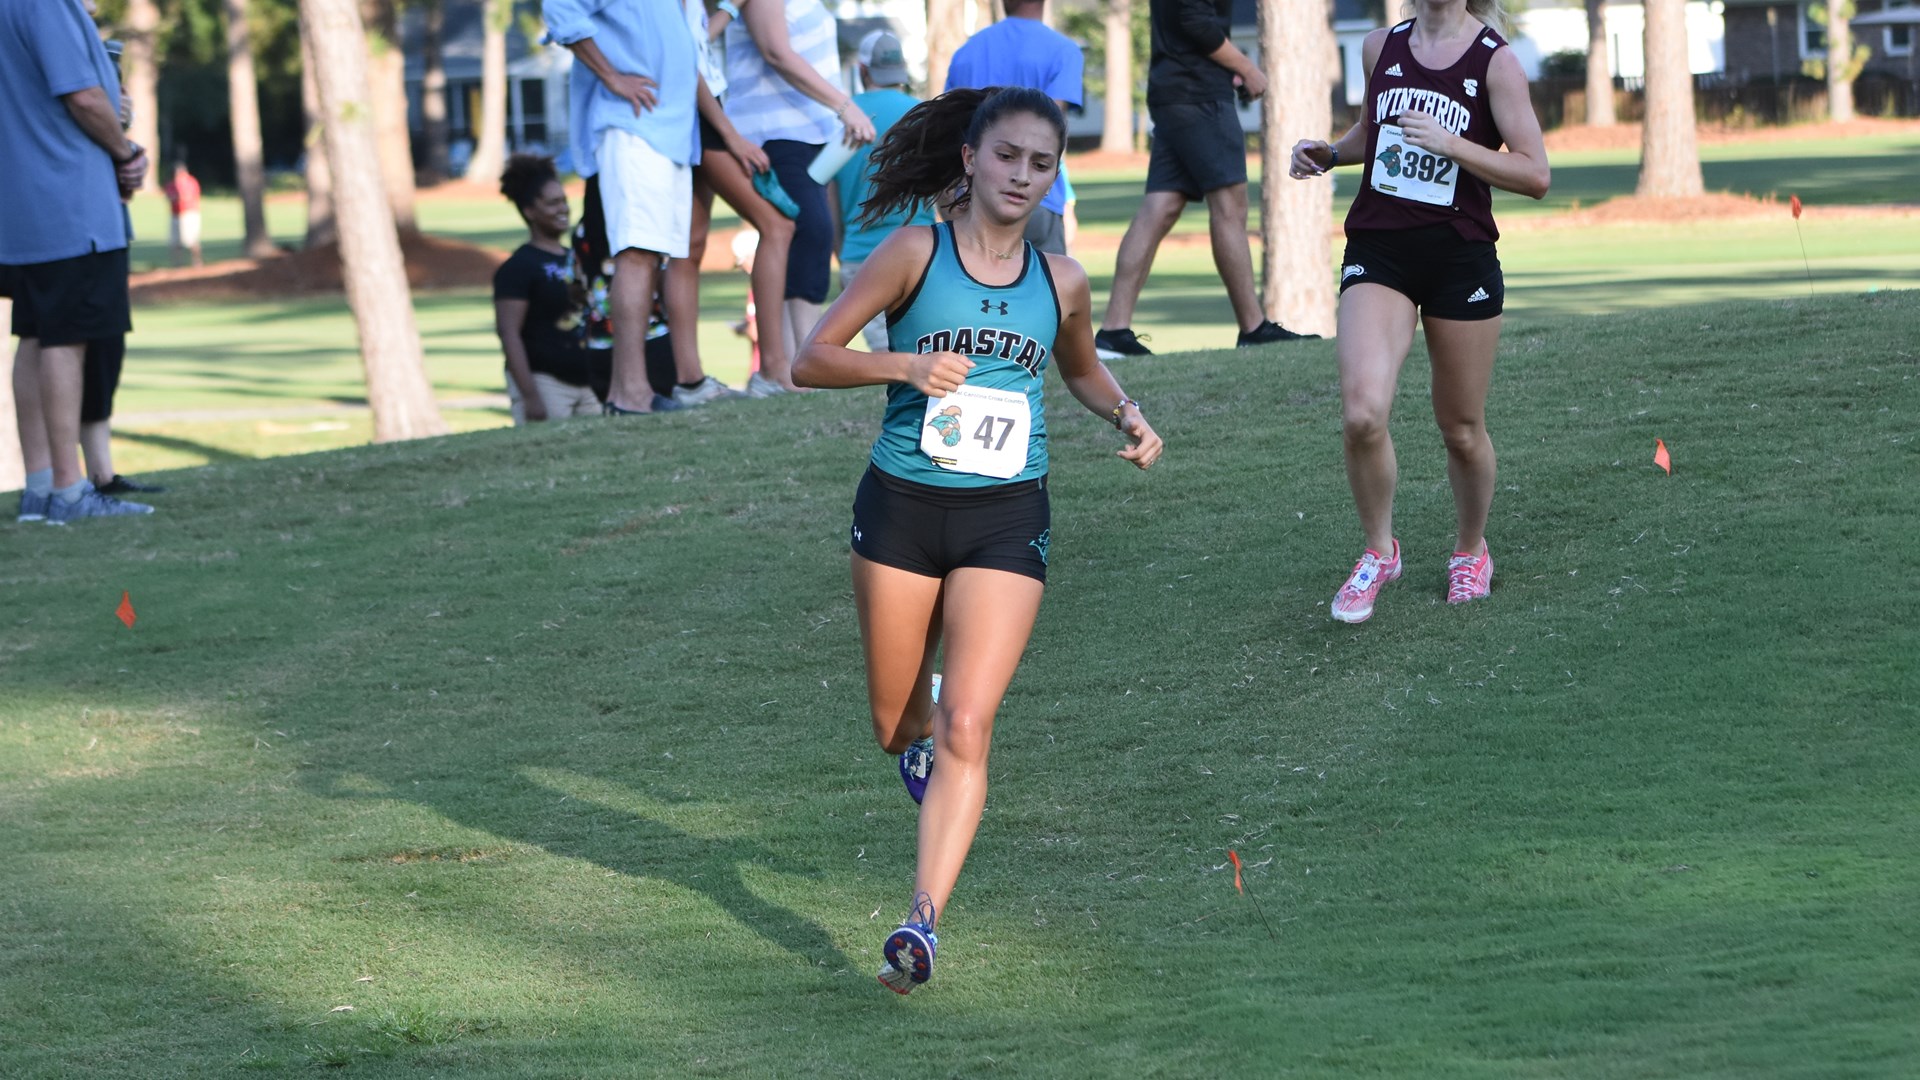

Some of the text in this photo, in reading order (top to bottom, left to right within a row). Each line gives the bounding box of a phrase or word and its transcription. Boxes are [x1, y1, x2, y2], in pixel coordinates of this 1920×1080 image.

[1376, 87, 1471, 137] WINTHROP
[1402, 151, 1454, 186] 392
[916, 327, 1047, 379] COASTAL
[973, 415, 1016, 451] 47
